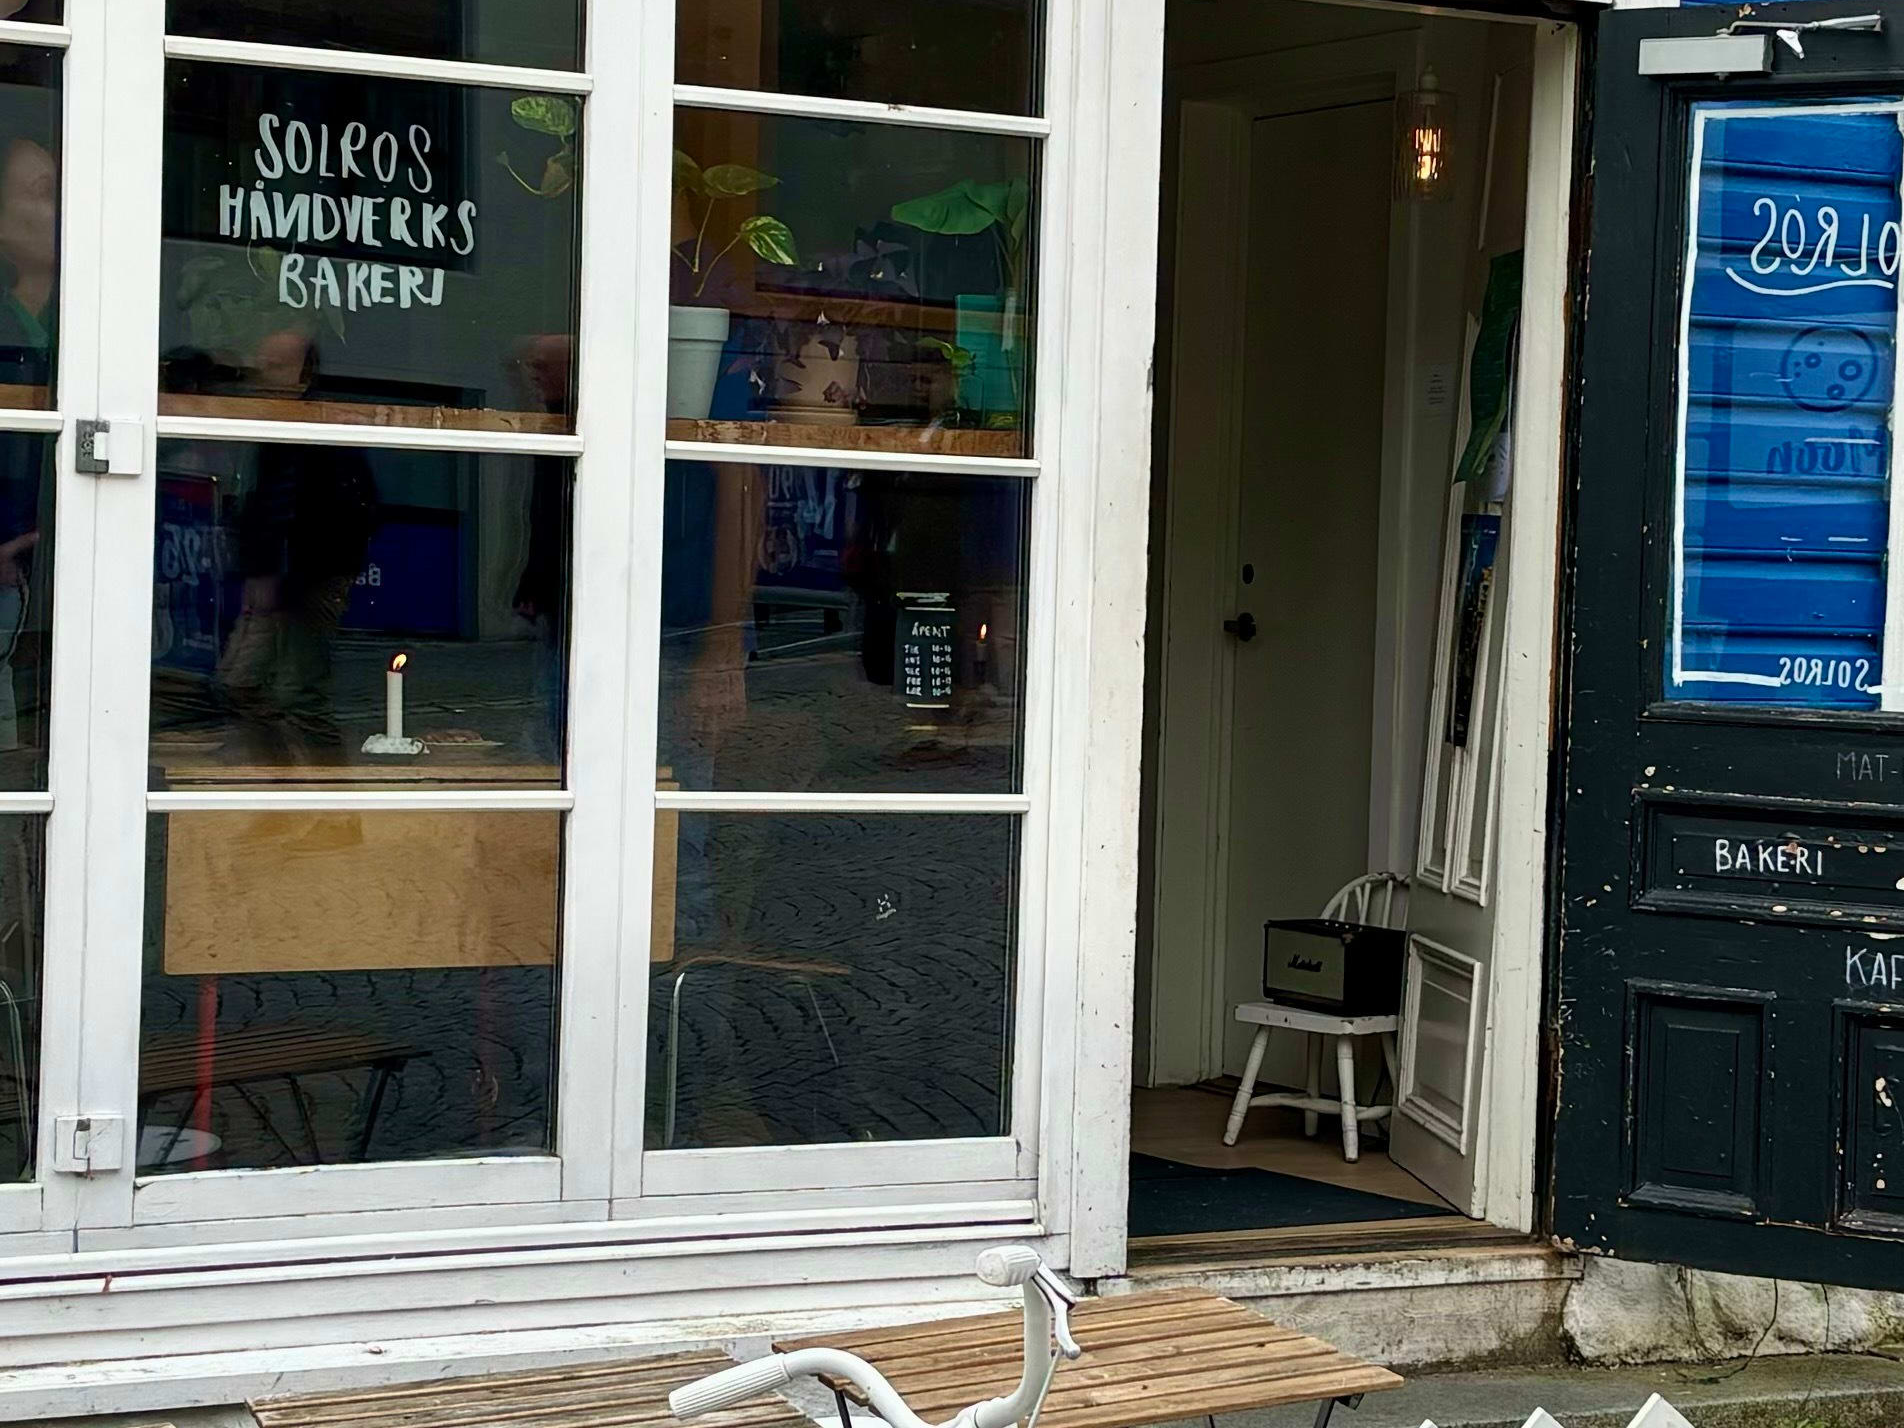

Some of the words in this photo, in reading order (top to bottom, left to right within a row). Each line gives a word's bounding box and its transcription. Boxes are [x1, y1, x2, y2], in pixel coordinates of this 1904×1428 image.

[254, 113, 432, 194] SOLROS
[219, 179, 477, 256] HÅNDVERKS
[279, 253, 445, 312] BAKERI
[1715, 837, 1824, 876] BAKERI
